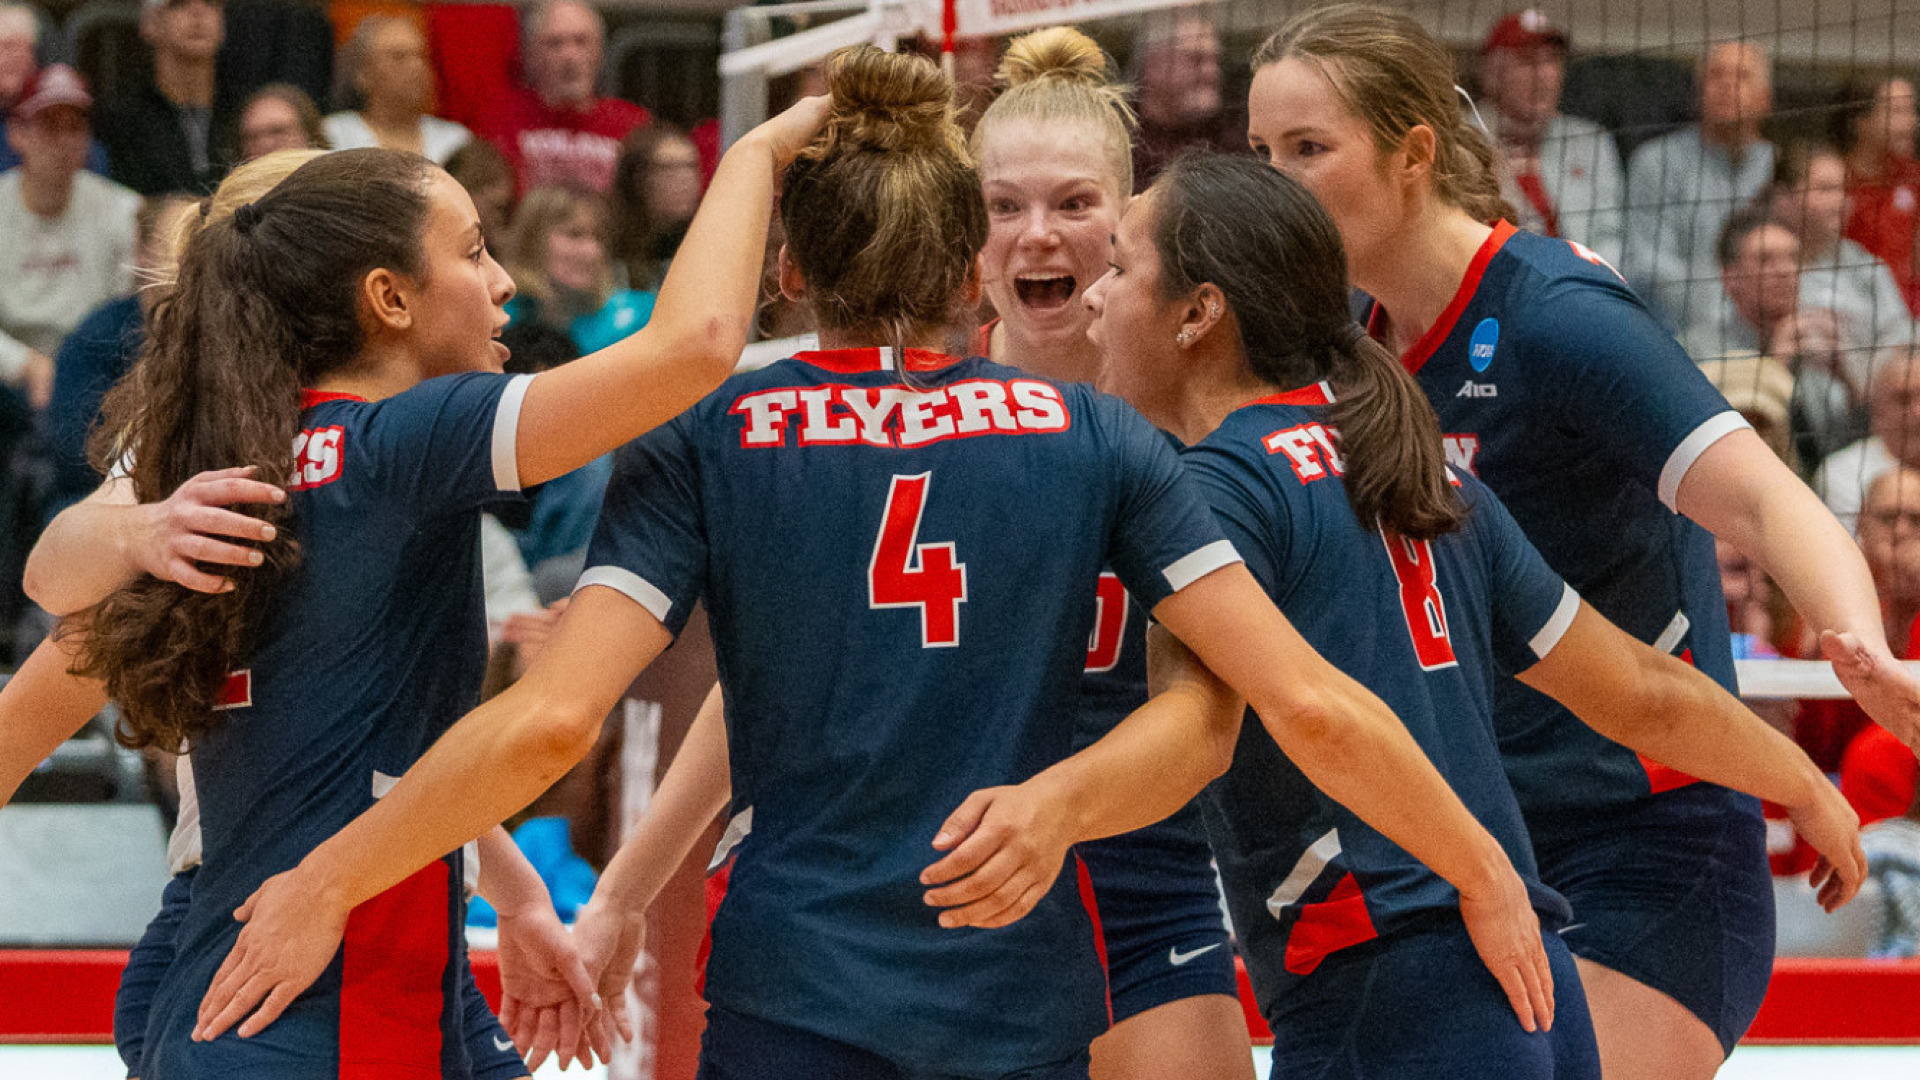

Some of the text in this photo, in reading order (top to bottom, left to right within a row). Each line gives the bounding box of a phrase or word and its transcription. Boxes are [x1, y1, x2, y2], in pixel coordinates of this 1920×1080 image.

[728, 378, 1071, 449] FLYERS
[868, 471, 968, 648] 4
[1376, 513, 1459, 672] 8
